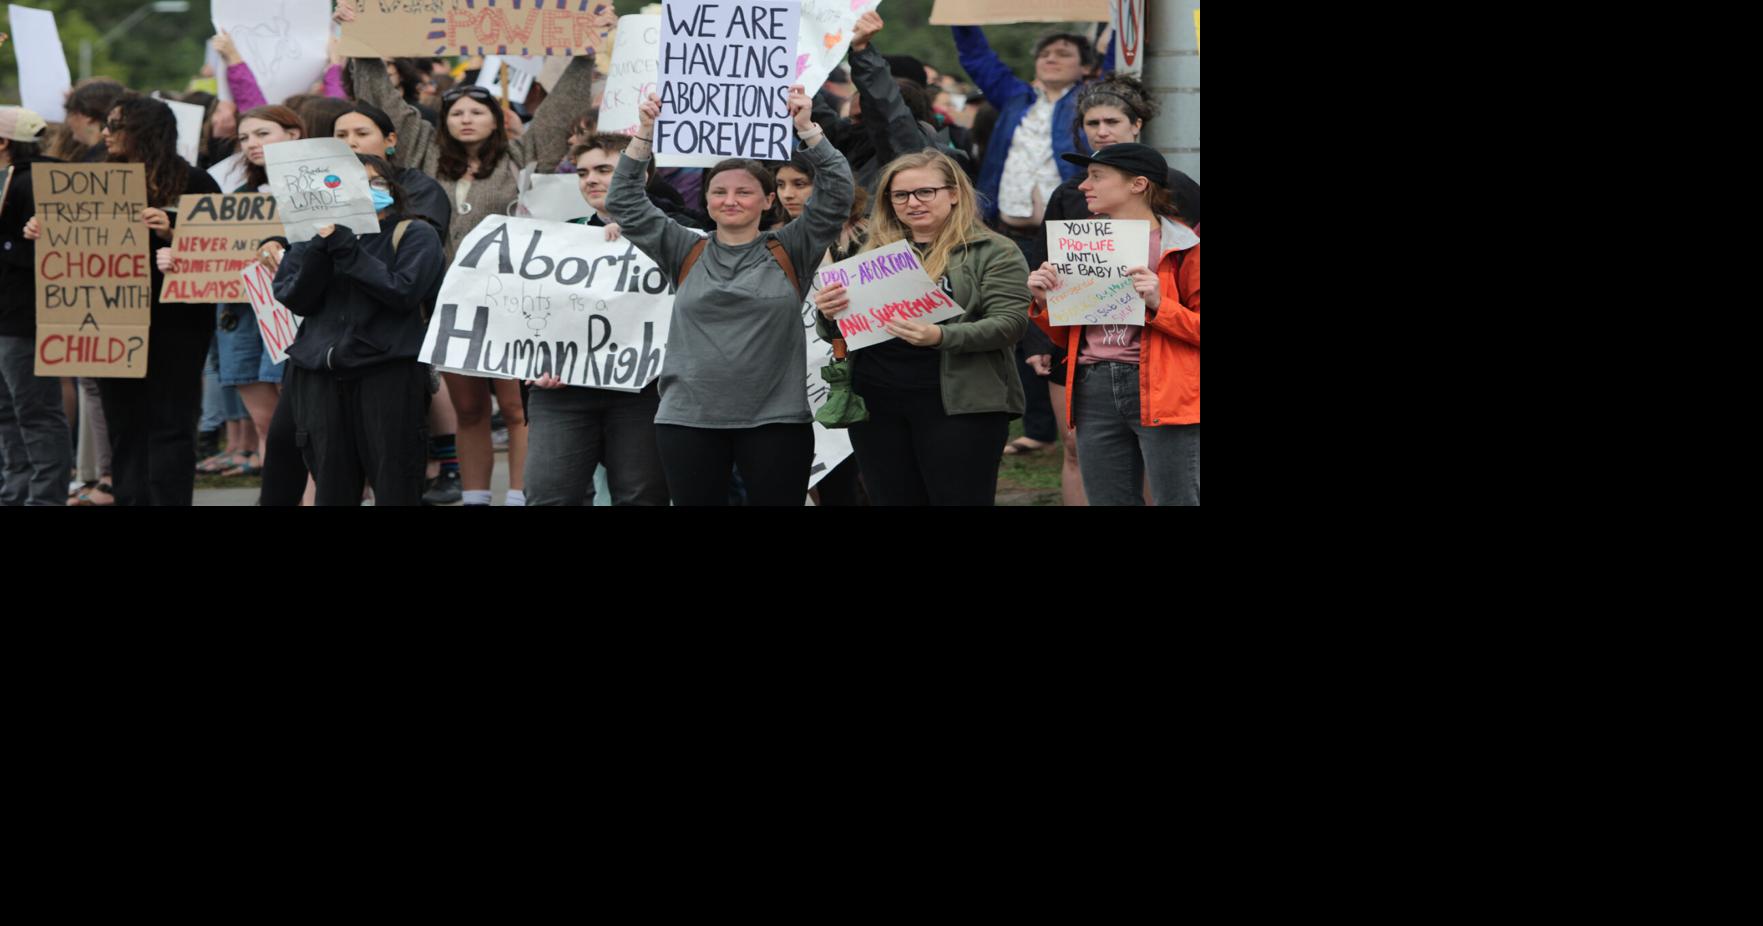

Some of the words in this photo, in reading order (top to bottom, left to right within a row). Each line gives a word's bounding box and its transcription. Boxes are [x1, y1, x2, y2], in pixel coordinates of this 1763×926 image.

[447, 7, 601, 49] POWER
[666, 3, 719, 38] WE
[725, 5, 788, 40] ARE
[664, 42, 788, 79] HAVING
[659, 80, 791, 119] ABORTIONS
[656, 120, 790, 161] FOREVER
[49, 168, 134, 196] DON'T
[38, 201, 109, 223] TRUST
[112, 201, 144, 221] ME
[45, 225, 114, 248] WITH
[122, 227, 138, 246] A
[1063, 222, 1114, 237] YOU'RE
[177, 236, 228, 252] NEVER
[231, 240, 246, 250] AN
[1058, 237, 1116, 252] PRO-LIFE
[1066, 252, 1108, 264] UNTIL
[40, 251, 147, 280] CHOICE
[821, 248, 919, 288] PRO-ABORTION
[1077, 263, 1112, 279] BABY
[1116, 264, 1130, 278] IS
[44, 285, 101, 309] BUT
[104, 285, 151, 309] WITH
[163, 279, 241, 300] ALWAYS
[484, 273, 552, 314] Rights
[568, 292, 585, 312] is
[595, 299, 609, 311] a
[79, 313, 100, 332] A
[838, 288, 954, 339] ANTI-SUPREMACY
[39, 334, 144, 368] CHILD?
[430, 303, 578, 384] Human
[582, 313, 668, 387] Righ
